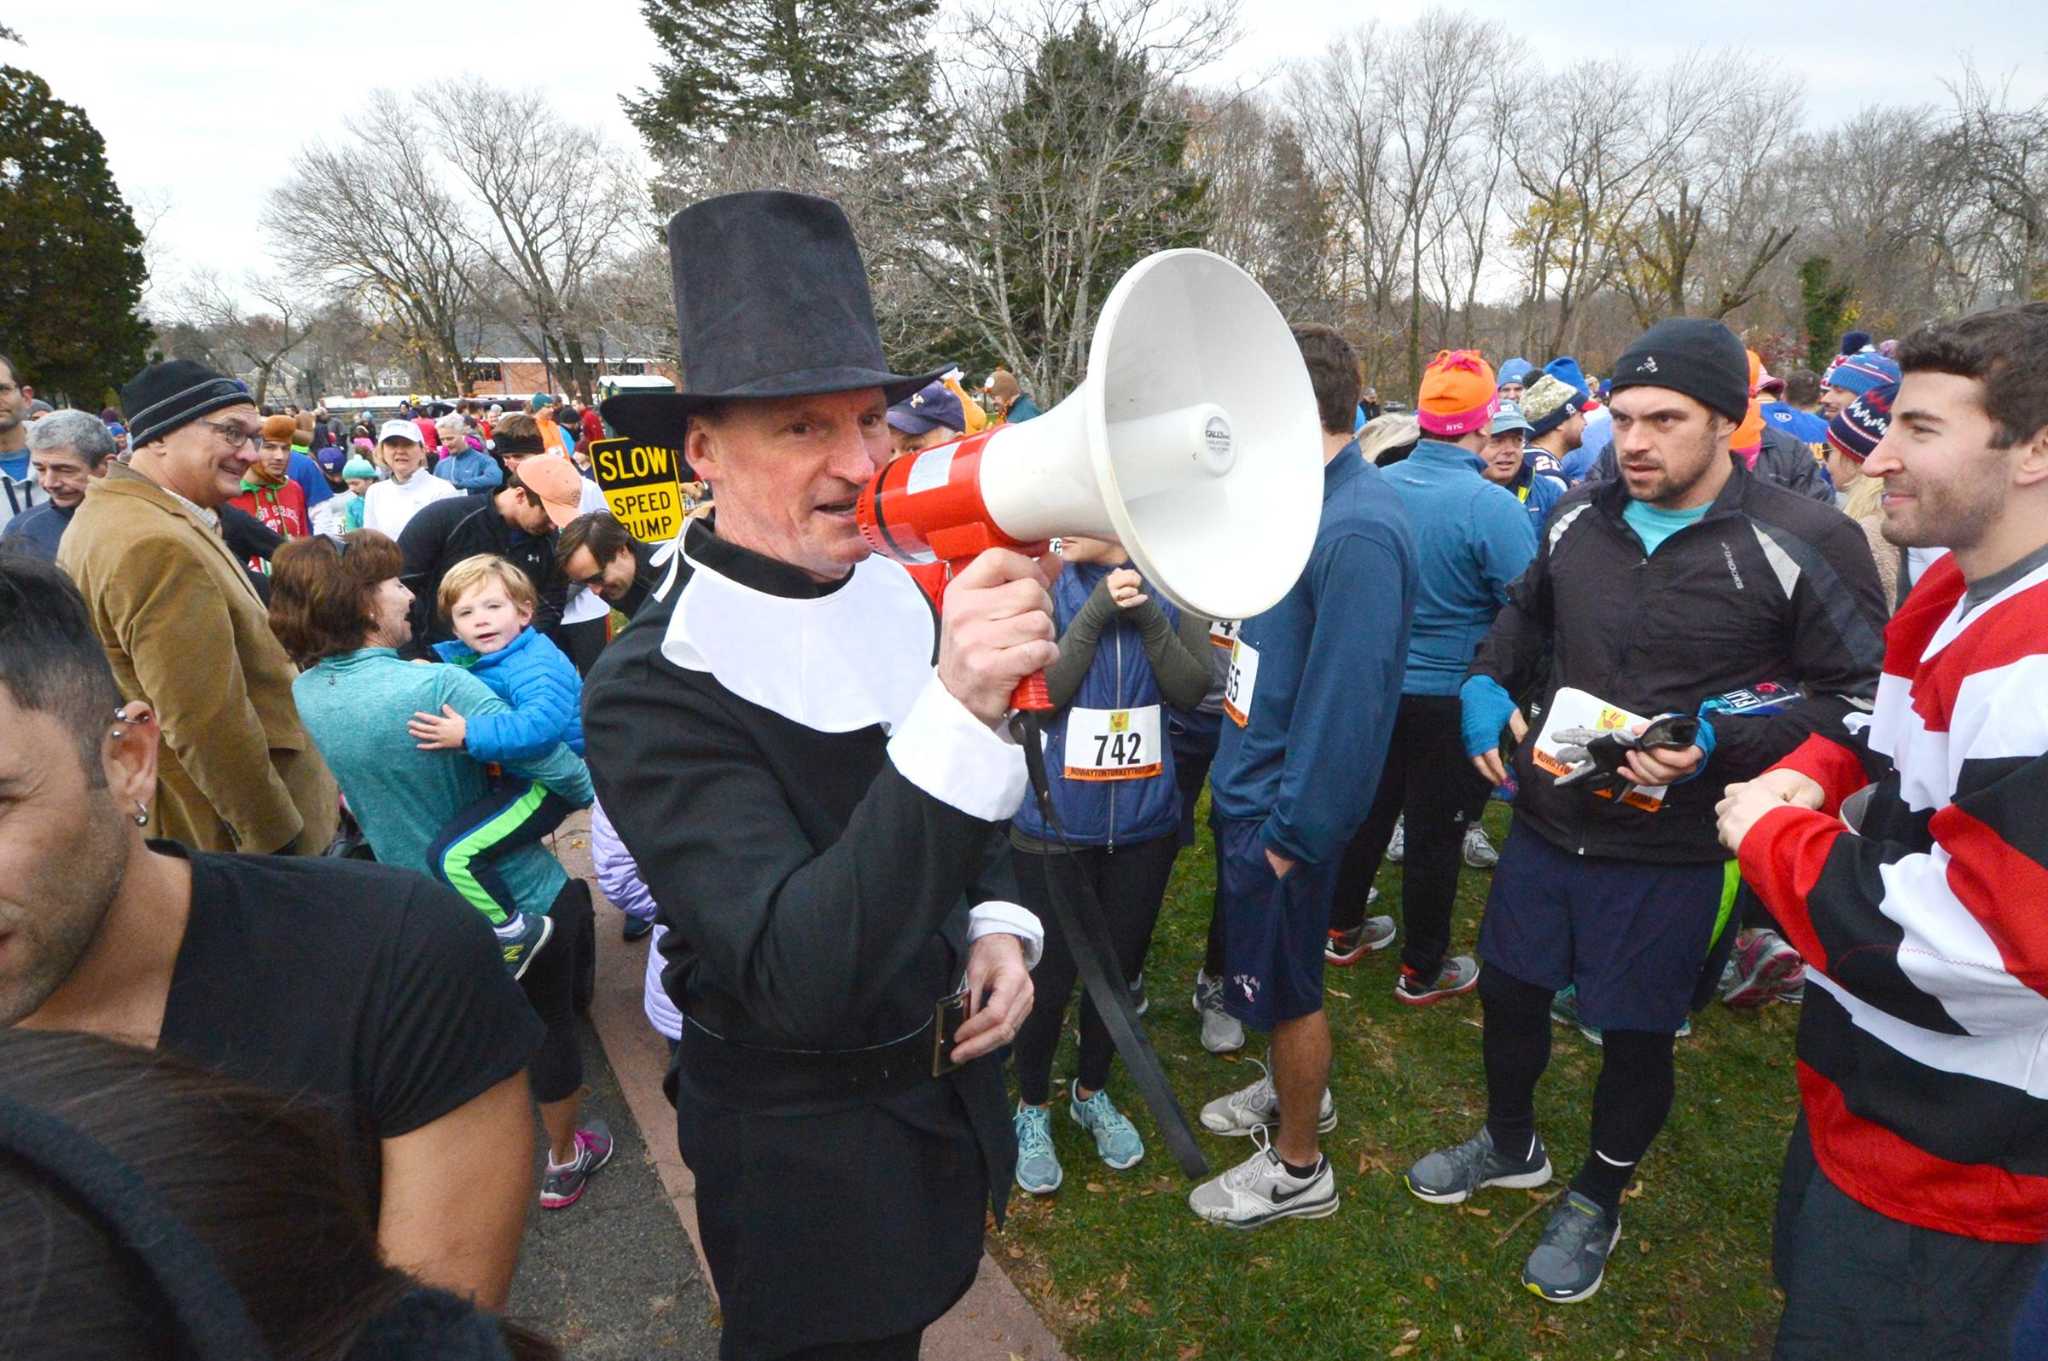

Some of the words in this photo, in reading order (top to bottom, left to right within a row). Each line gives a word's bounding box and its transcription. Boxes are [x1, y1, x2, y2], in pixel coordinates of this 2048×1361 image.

[599, 446, 667, 482] SLOW
[613, 491, 671, 517] SPEED
[1094, 732, 1142, 767] 742
